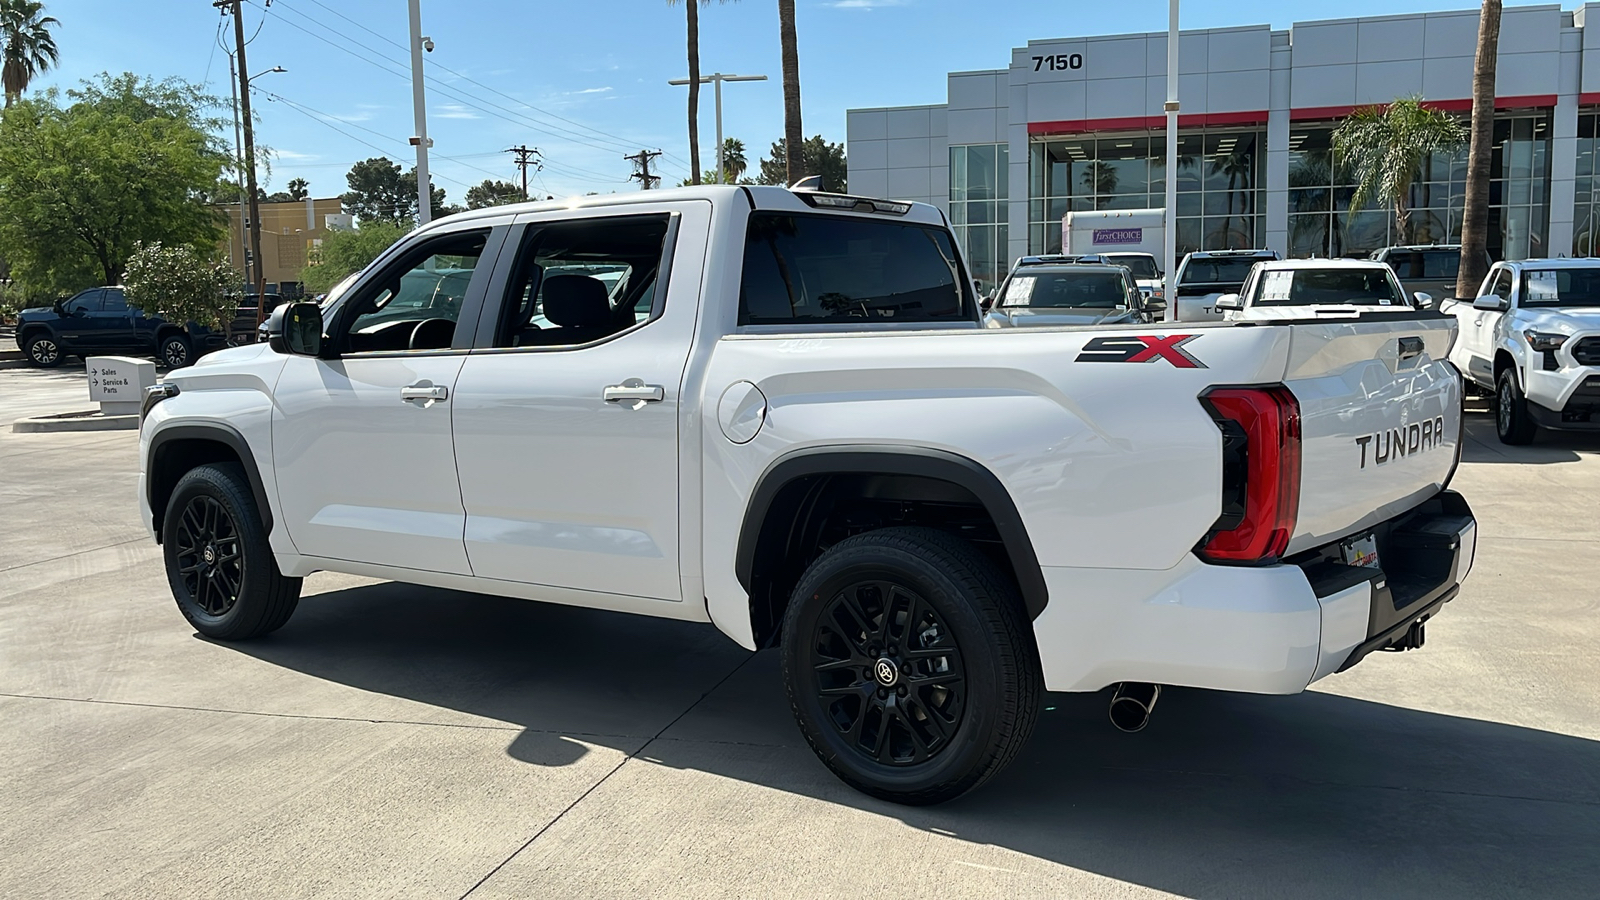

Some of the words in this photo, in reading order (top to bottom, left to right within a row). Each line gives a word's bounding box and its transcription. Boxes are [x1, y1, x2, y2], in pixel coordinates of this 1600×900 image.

[1031, 53, 1083, 72] 7150
[1074, 334, 1210, 369] SX
[1355, 416, 1443, 469] TUNDRA
